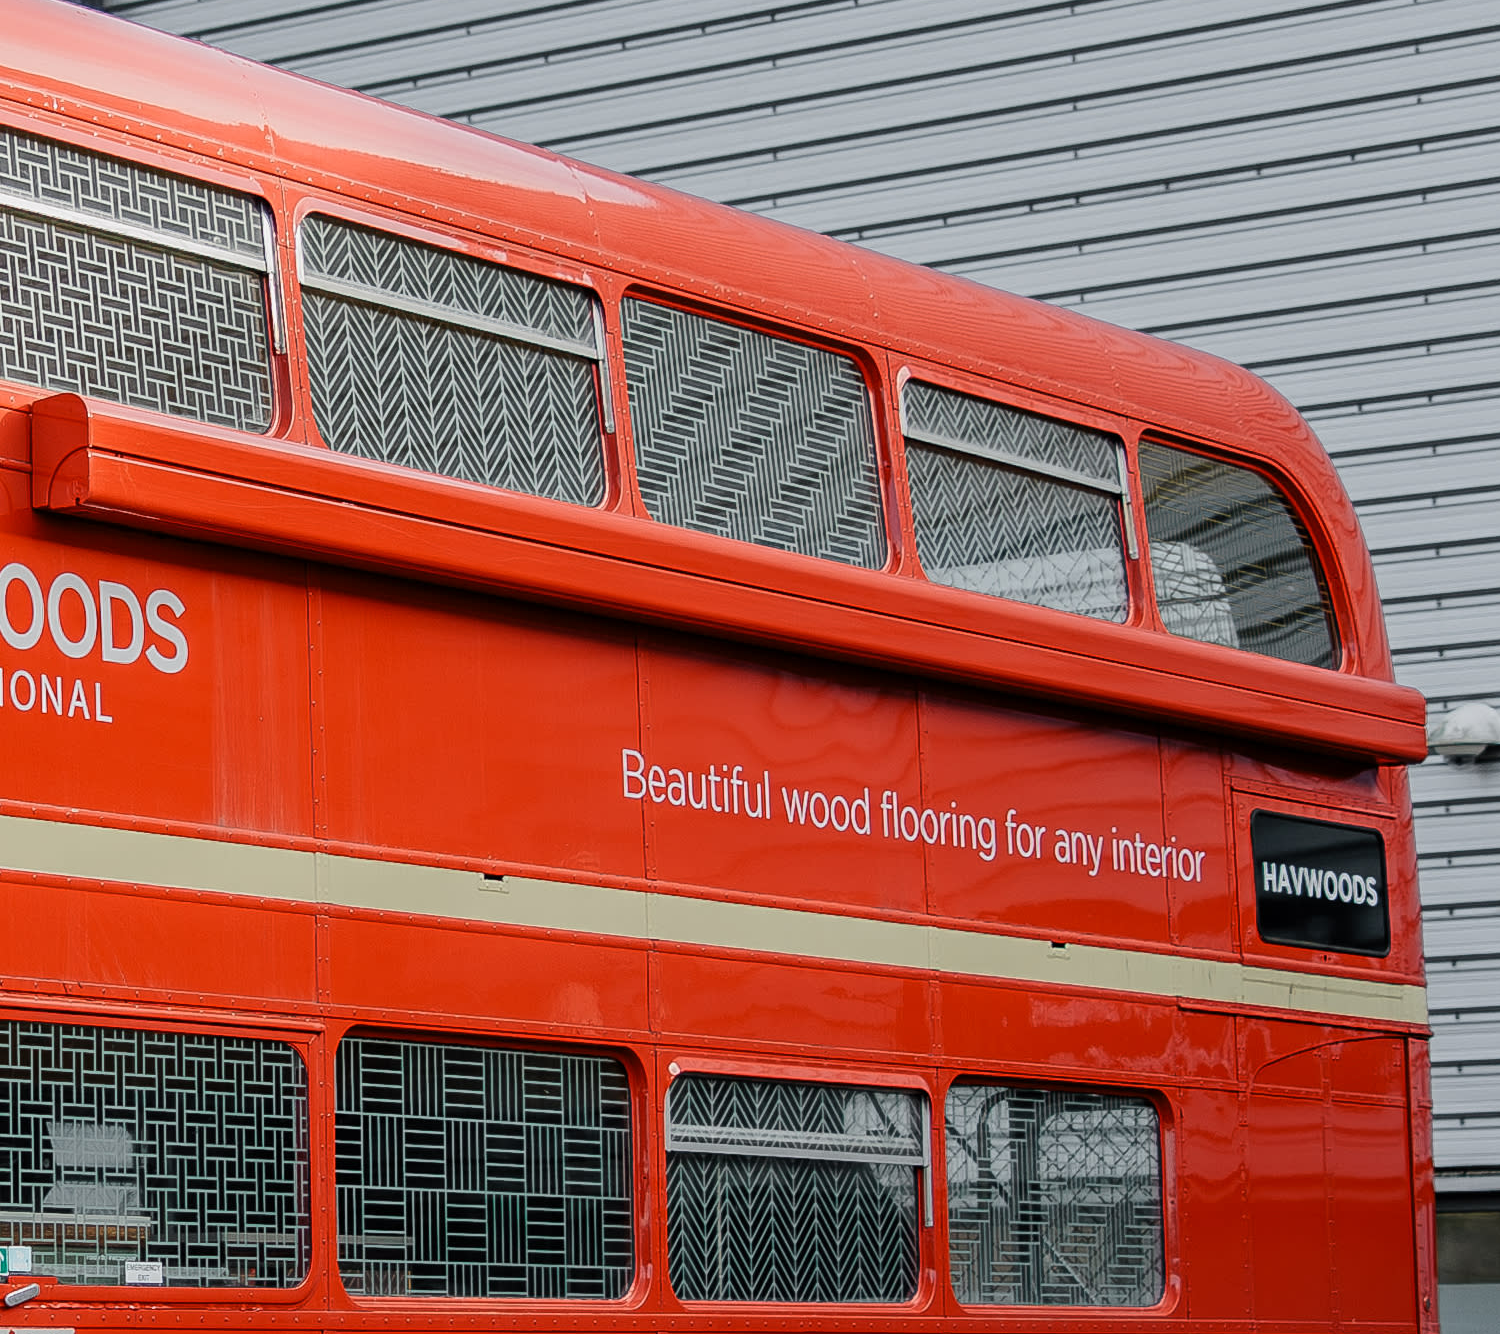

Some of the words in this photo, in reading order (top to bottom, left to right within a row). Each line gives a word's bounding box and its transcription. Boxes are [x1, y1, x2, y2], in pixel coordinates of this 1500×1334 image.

[622, 748, 771, 821] Beautiful
[782, 785, 871, 837] wood
[881, 790, 997, 862] flooring
[1006, 809, 1046, 856] for
[1054, 830, 1105, 878] any
[1111, 827, 1206, 883] interior
[1262, 861, 1378, 907] HAVWOODS
